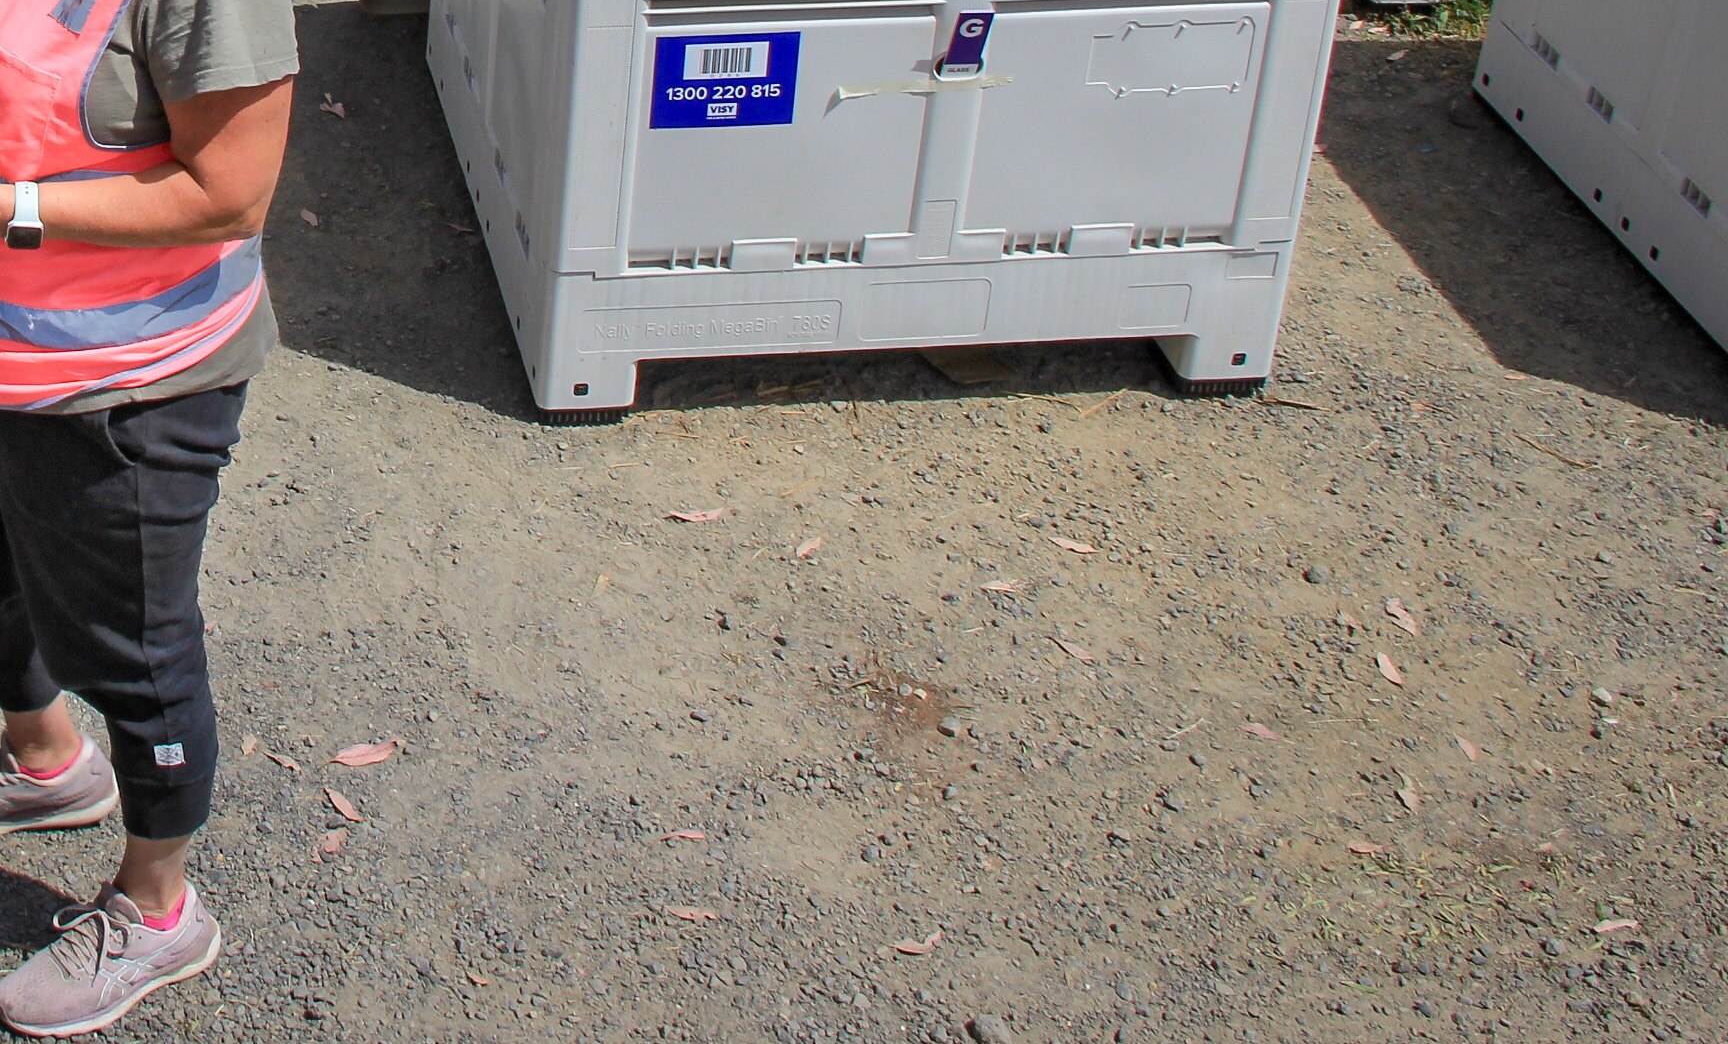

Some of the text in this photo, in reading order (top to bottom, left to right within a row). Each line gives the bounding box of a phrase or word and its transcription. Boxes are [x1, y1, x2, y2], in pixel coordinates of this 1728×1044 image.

[959, 18, 984, 38] G
[666, 83, 781, 101] 1300 220 815
[709, 105, 735, 114] VISY
[594, 323, 634, 341] Nally
[644, 319, 704, 339] Folding
[709, 317, 778, 337] MegaBin
